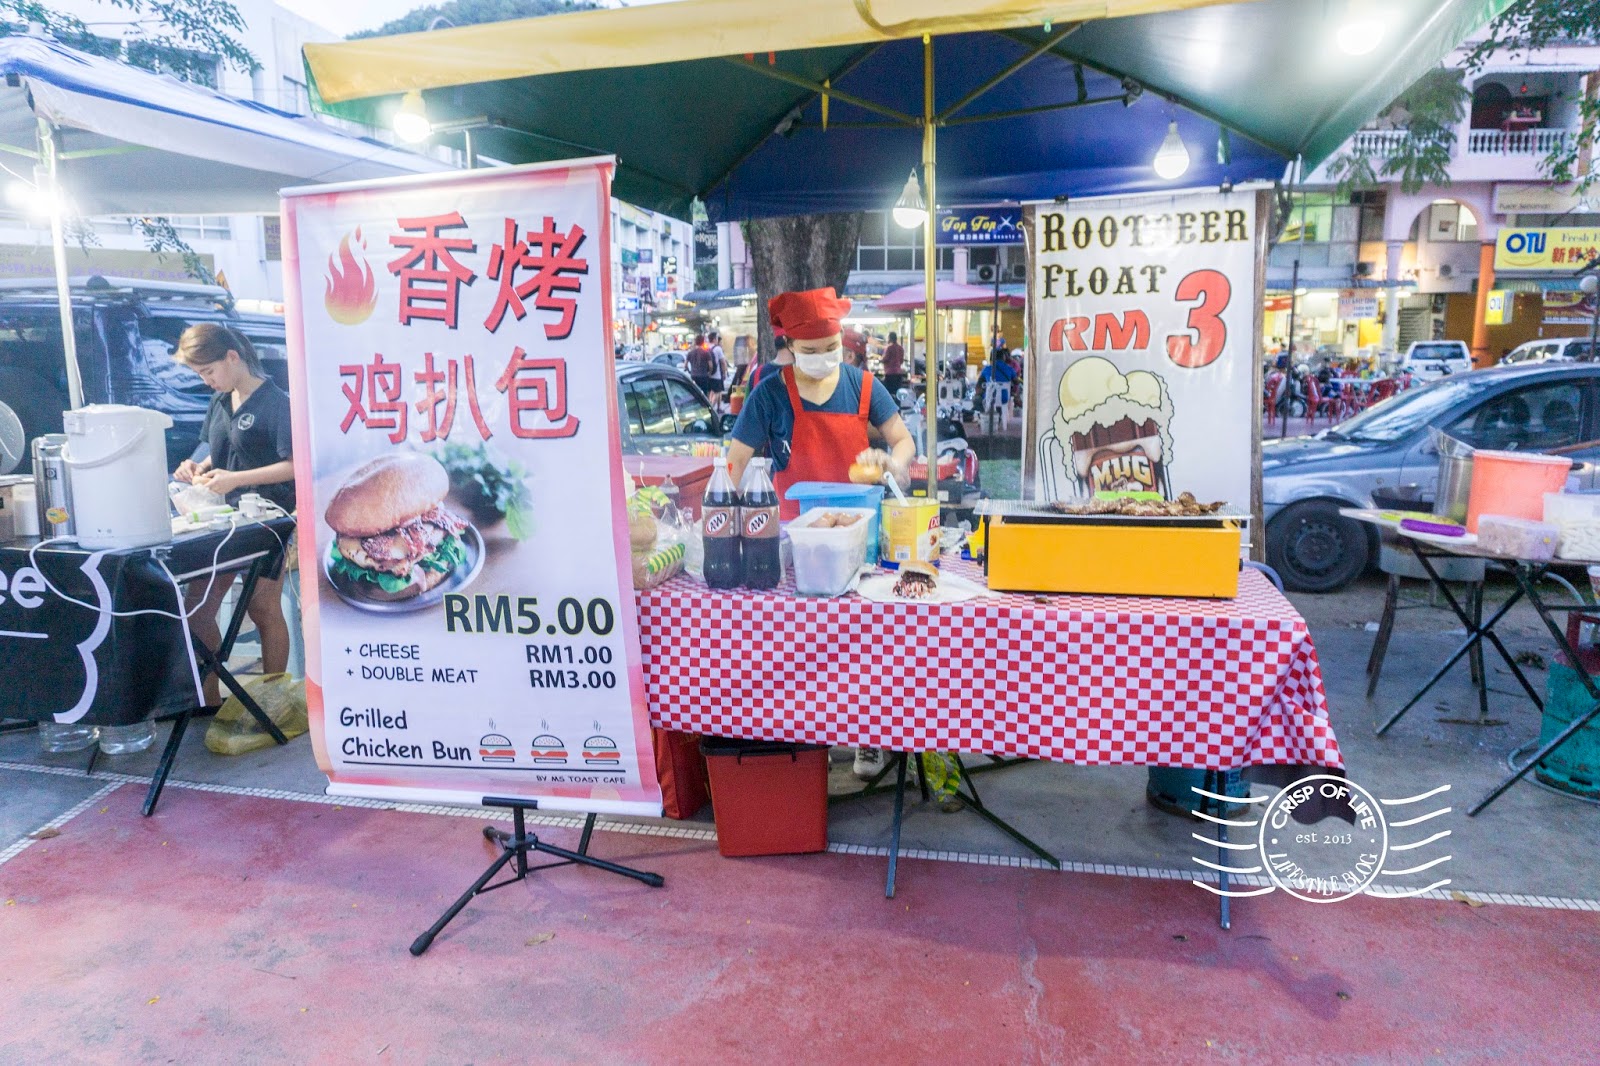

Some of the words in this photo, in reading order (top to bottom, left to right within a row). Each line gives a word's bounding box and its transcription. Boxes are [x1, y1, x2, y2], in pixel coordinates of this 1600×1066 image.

[941, 215, 967, 233] Top
[971, 215, 997, 233] Top
[386, 210, 589, 340] 香烤
[1041, 263, 1167, 299] FLOAT
[1049, 309, 1151, 352] RM
[1166, 268, 1232, 369] 3
[339, 345, 581, 444] 鸡扒包
[1089, 454, 1152, 492] MUG
[444, 593, 615, 636] RM5.00
[359, 643, 420, 660] CHEESE
[525, 644, 613, 665] RM1.00
[361, 665, 424, 682] DOUBLE
[431, 668, 478, 684] MEAT
[529, 669, 617, 689] RM3.00
[339, 707, 408, 730] Grilled
[341, 737, 424, 760] Chicken
[432, 740, 472, 761] Bun
[536, 775, 547, 783] BY
[551, 775, 566, 783] MS
[568, 775, 599, 784] TOAST
[603, 776, 626, 785] CAFE
